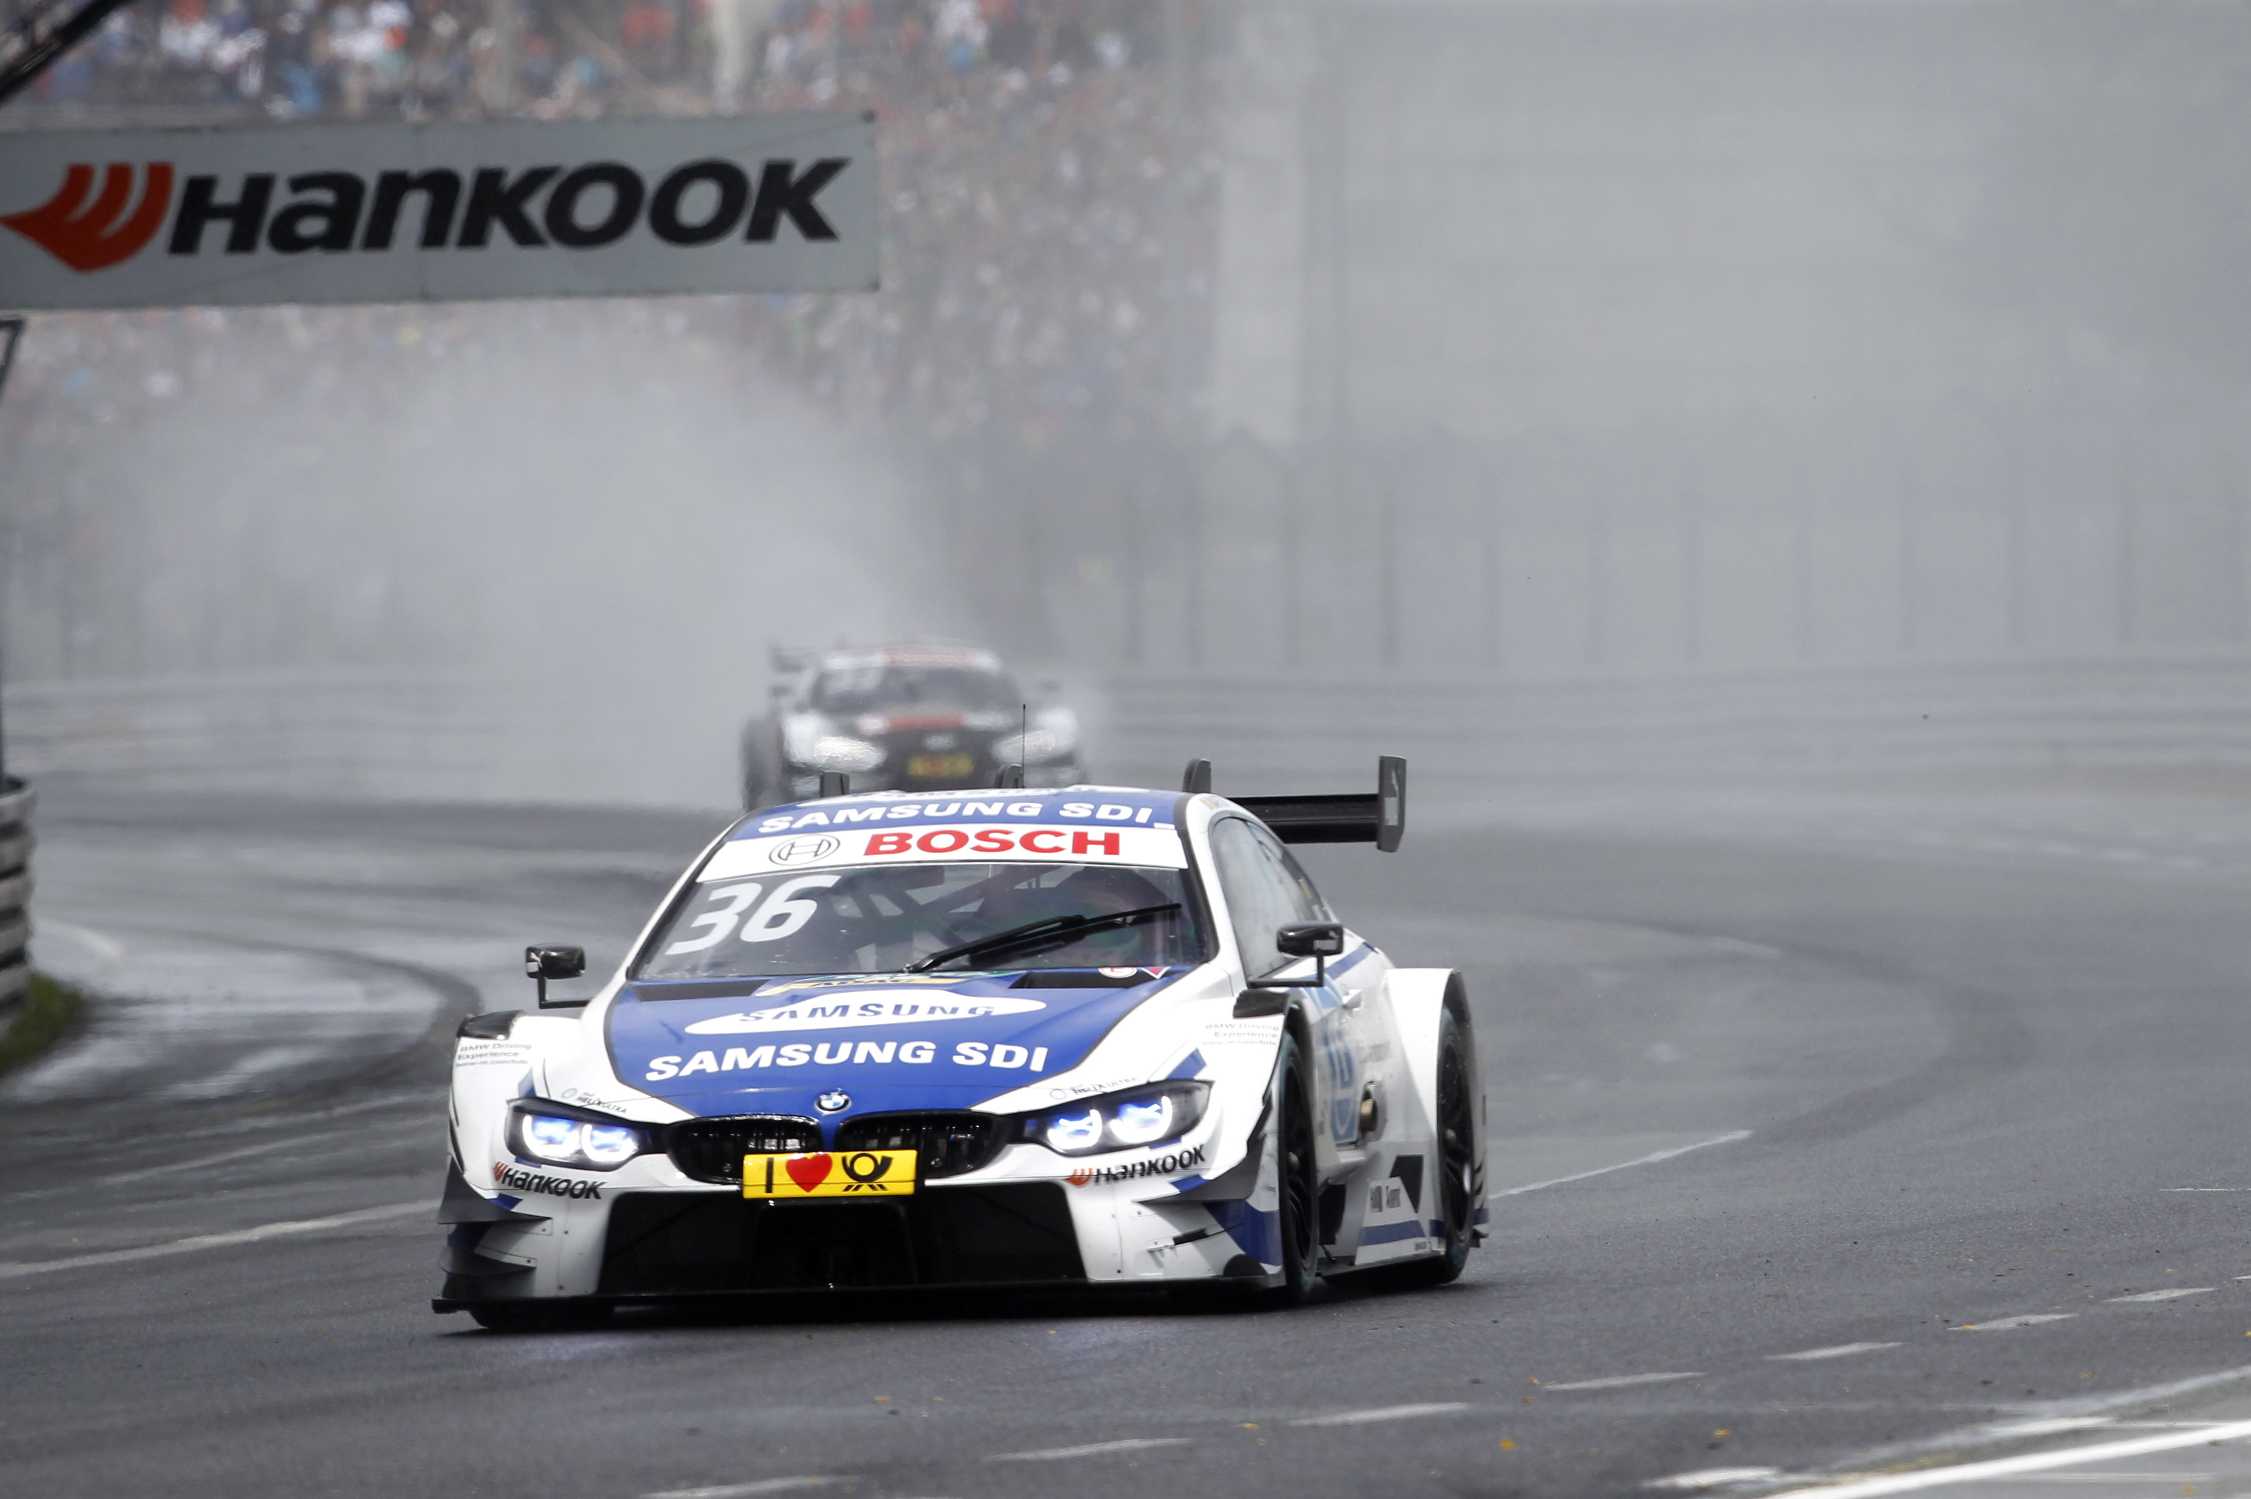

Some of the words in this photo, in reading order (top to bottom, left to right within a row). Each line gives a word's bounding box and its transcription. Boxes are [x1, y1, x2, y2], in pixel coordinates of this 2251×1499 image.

[757, 801, 1043, 834] SAMSUNG
[1058, 801, 1154, 825] SDI
[863, 829, 1120, 856] BOSCH
[665, 874, 841, 956] 36
[738, 1002, 995, 1023] SAMSUNG
[644, 1038, 936, 1082] SAMSUNG
[951, 1040, 1050, 1073] SDI
[765, 1157, 774, 1194] I
